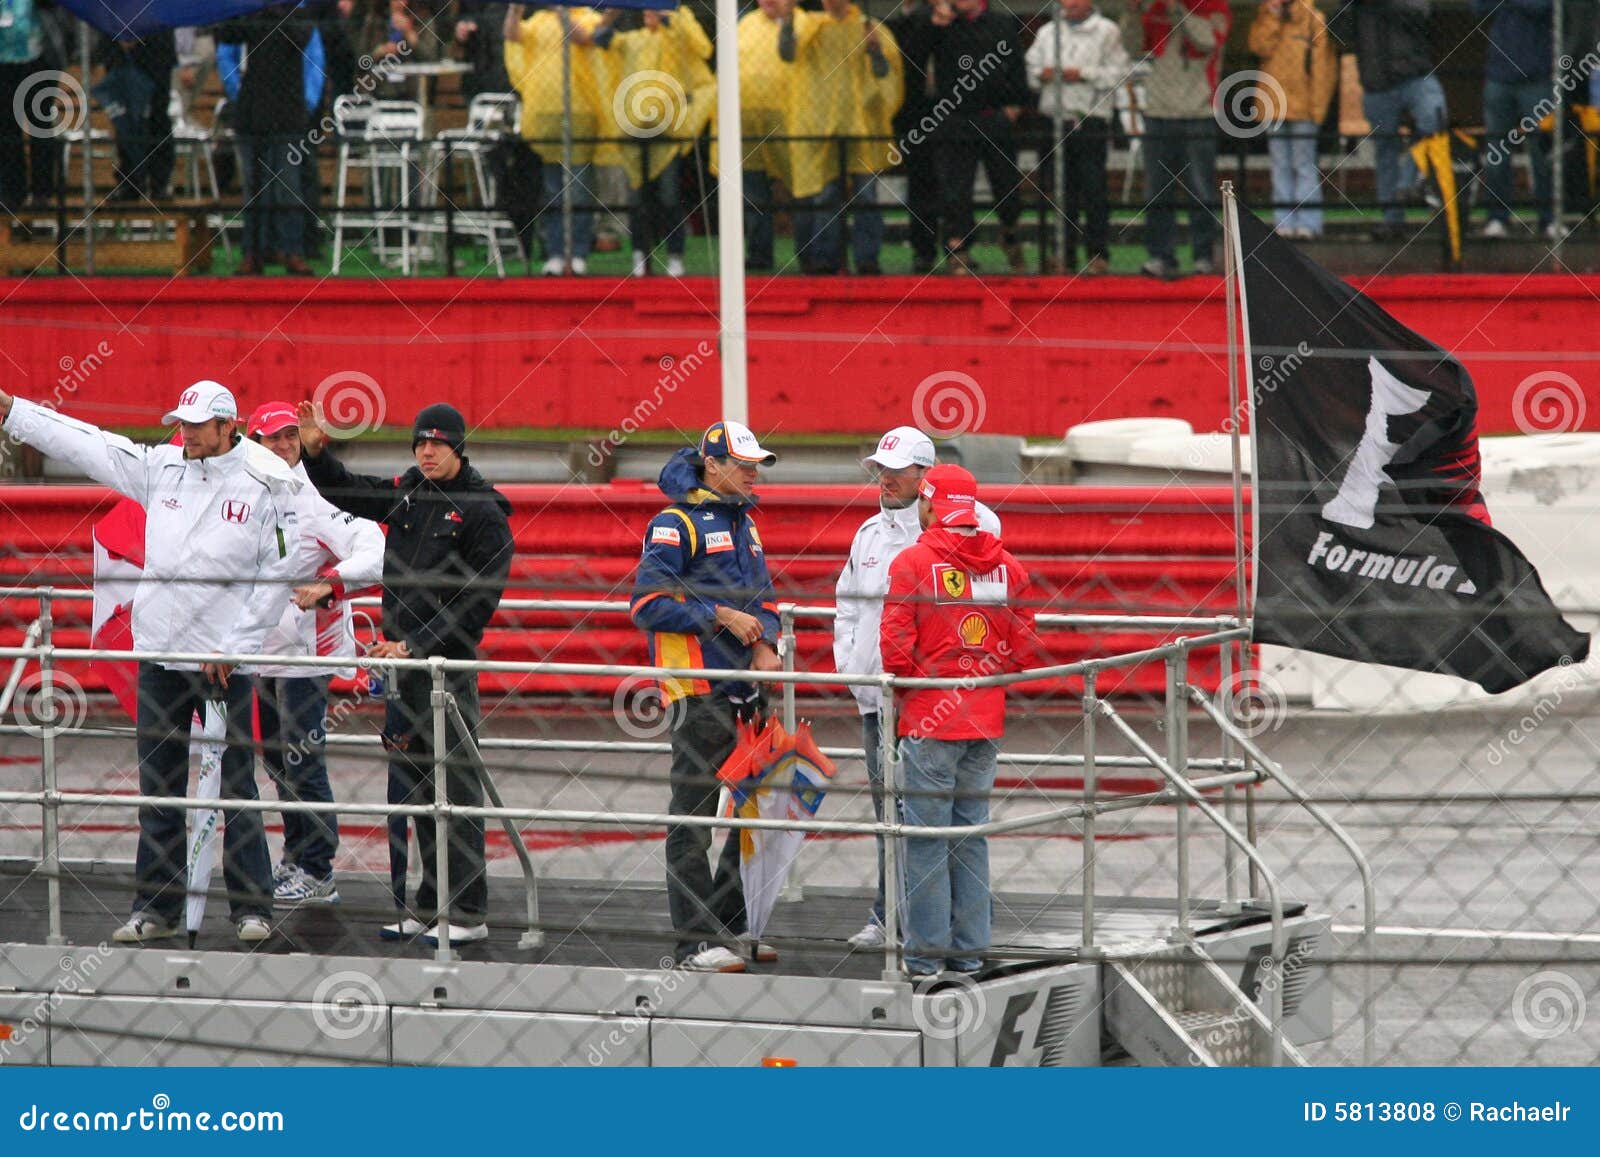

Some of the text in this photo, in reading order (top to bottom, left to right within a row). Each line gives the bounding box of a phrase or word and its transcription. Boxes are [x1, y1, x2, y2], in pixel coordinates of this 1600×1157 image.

[654, 528, 669, 537] ING
[706, 534, 723, 546] ING
[1307, 531, 1457, 590] Formula
